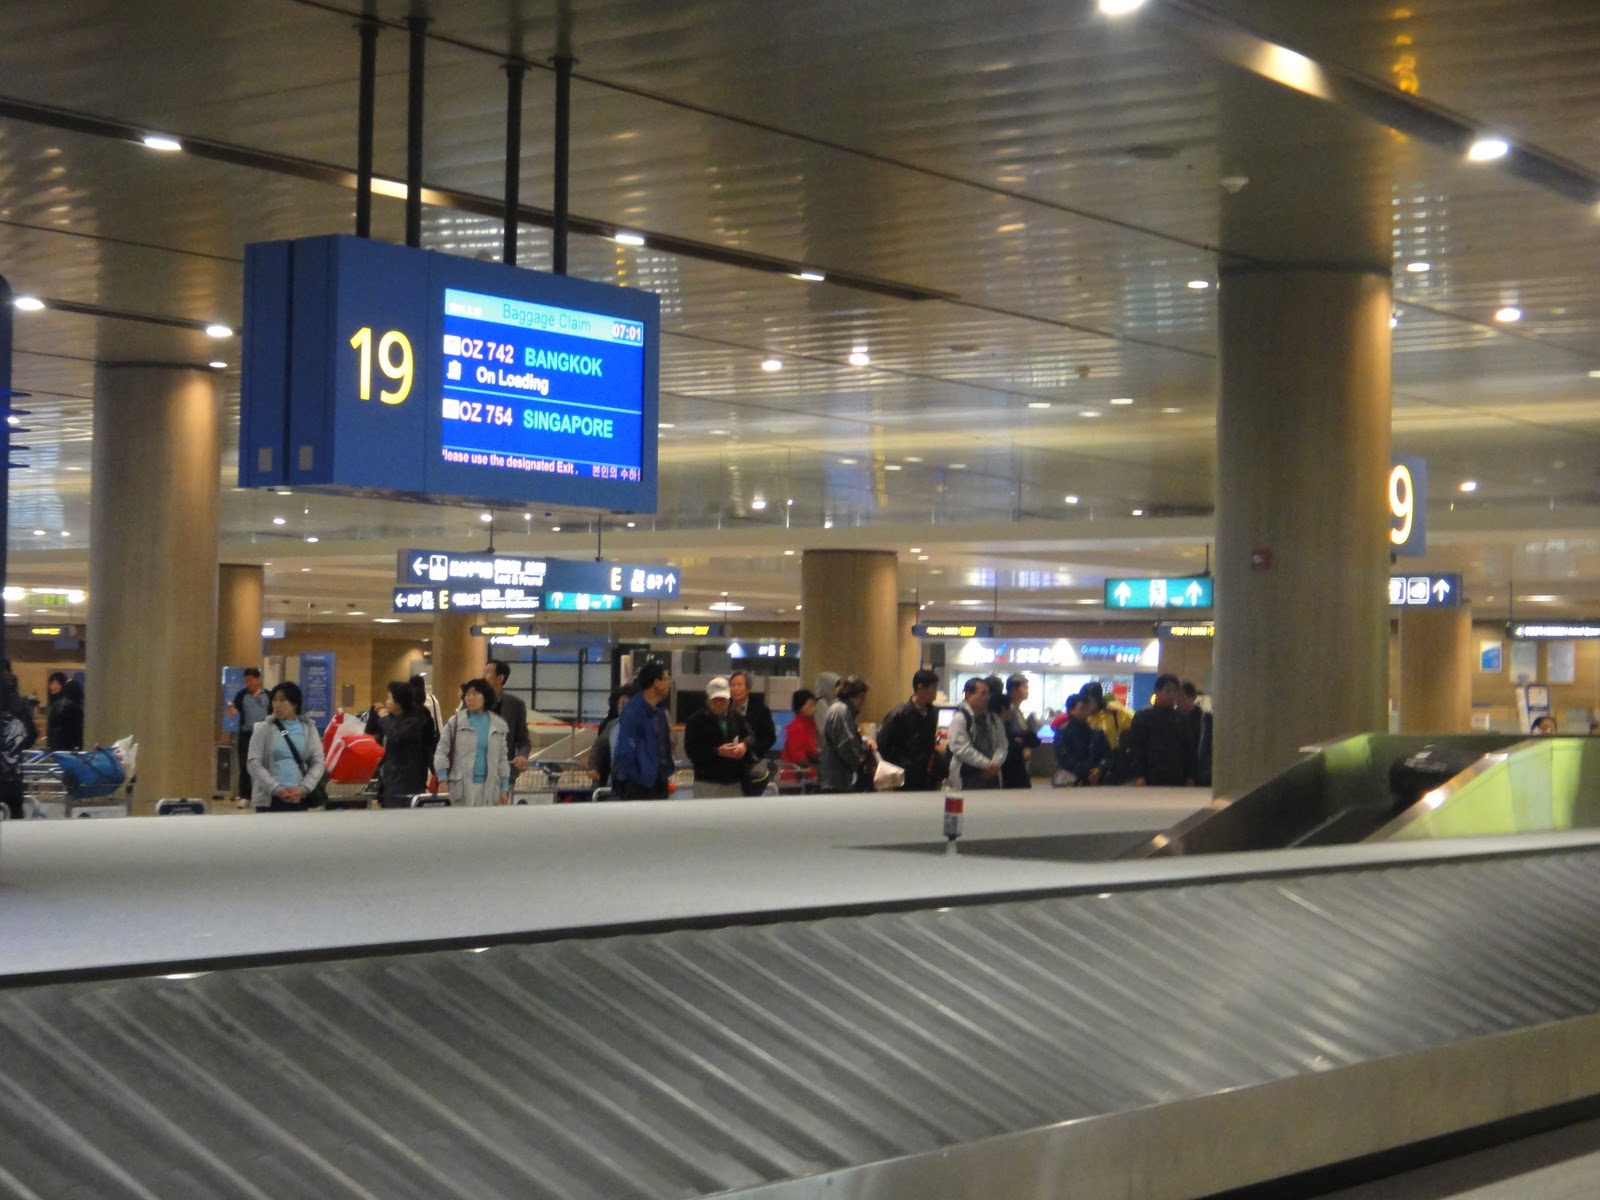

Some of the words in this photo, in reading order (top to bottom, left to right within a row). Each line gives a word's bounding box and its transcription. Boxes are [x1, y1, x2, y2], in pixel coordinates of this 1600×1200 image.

[502, 303, 555, 329] Baggage
[559, 313, 592, 333] Claim
[613, 323, 641, 341] 07:01
[349, 326, 414, 405] 19
[461, 337, 484, 359] OZ
[487, 341, 514, 364] 742
[525, 347, 602, 377] BANGKOK
[476, 365, 496, 385] On
[498, 368, 550, 395] Loading
[459, 401, 482, 423] OZ
[485, 404, 513, 427] 754
[523, 408, 613, 438] SINGAPORE
[442, 448, 469, 463] lease
[470, 453, 488, 465] use
[489, 453, 505, 467] the
[506, 455, 555, 473] designated
[620, 468, 641, 482] 수하
[611, 567, 622, 591] E
[439, 590, 449, 609] E
